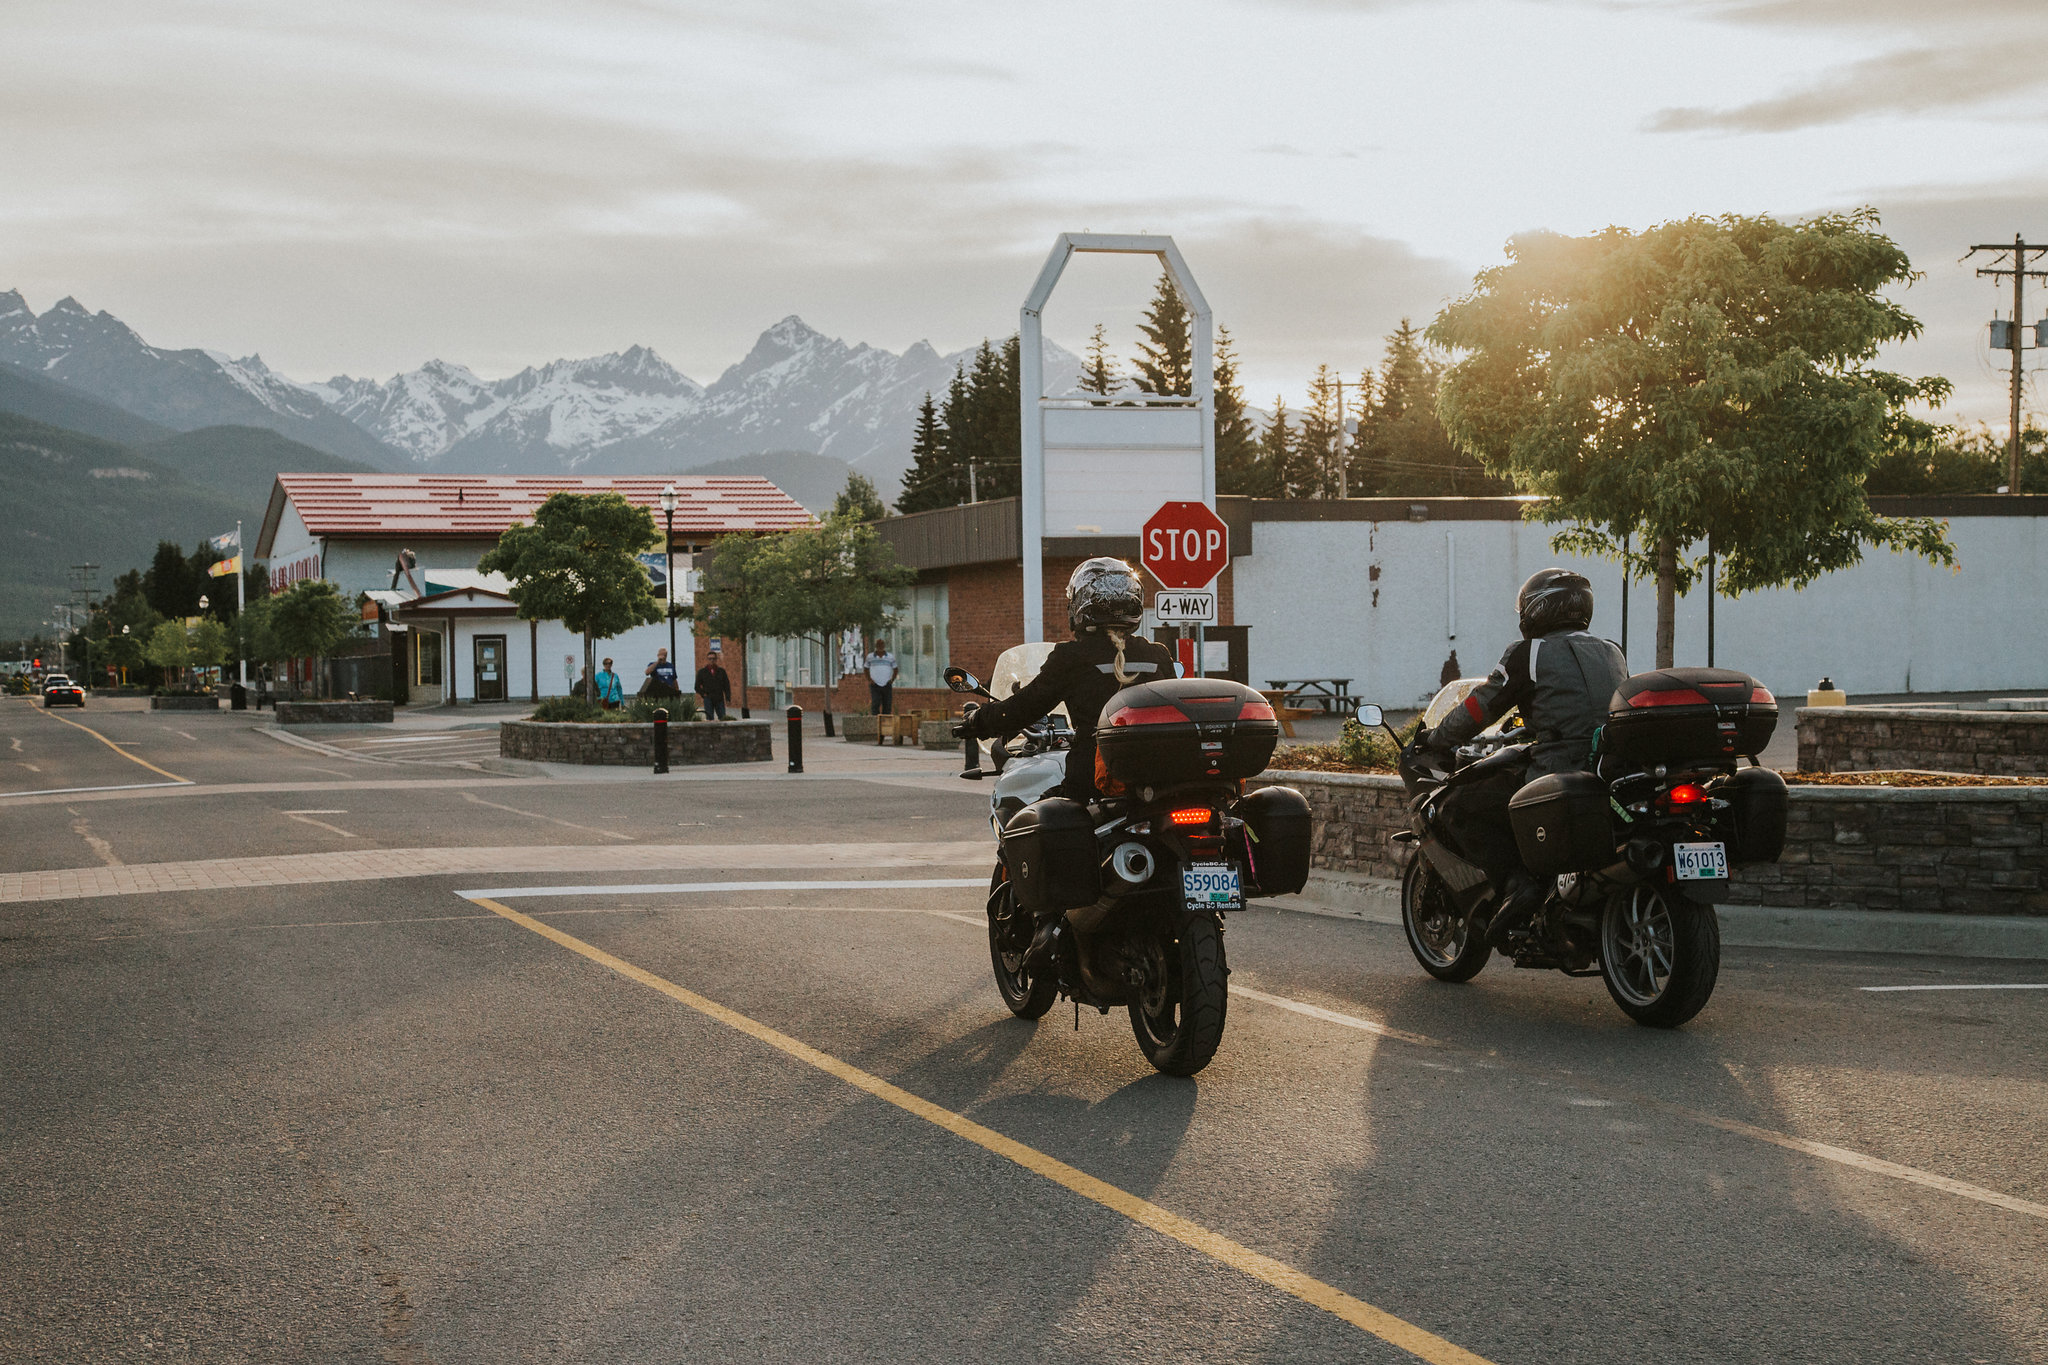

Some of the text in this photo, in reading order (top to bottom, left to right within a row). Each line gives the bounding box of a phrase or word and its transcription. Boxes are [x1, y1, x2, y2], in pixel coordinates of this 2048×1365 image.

[1149, 528, 1221, 562] STOP
[1160, 598, 1209, 615] 4-WAY
[1678, 852, 1725, 868] W61013
[1184, 874, 1239, 891] S59084
[1186, 902, 1205, 910] Cycle
